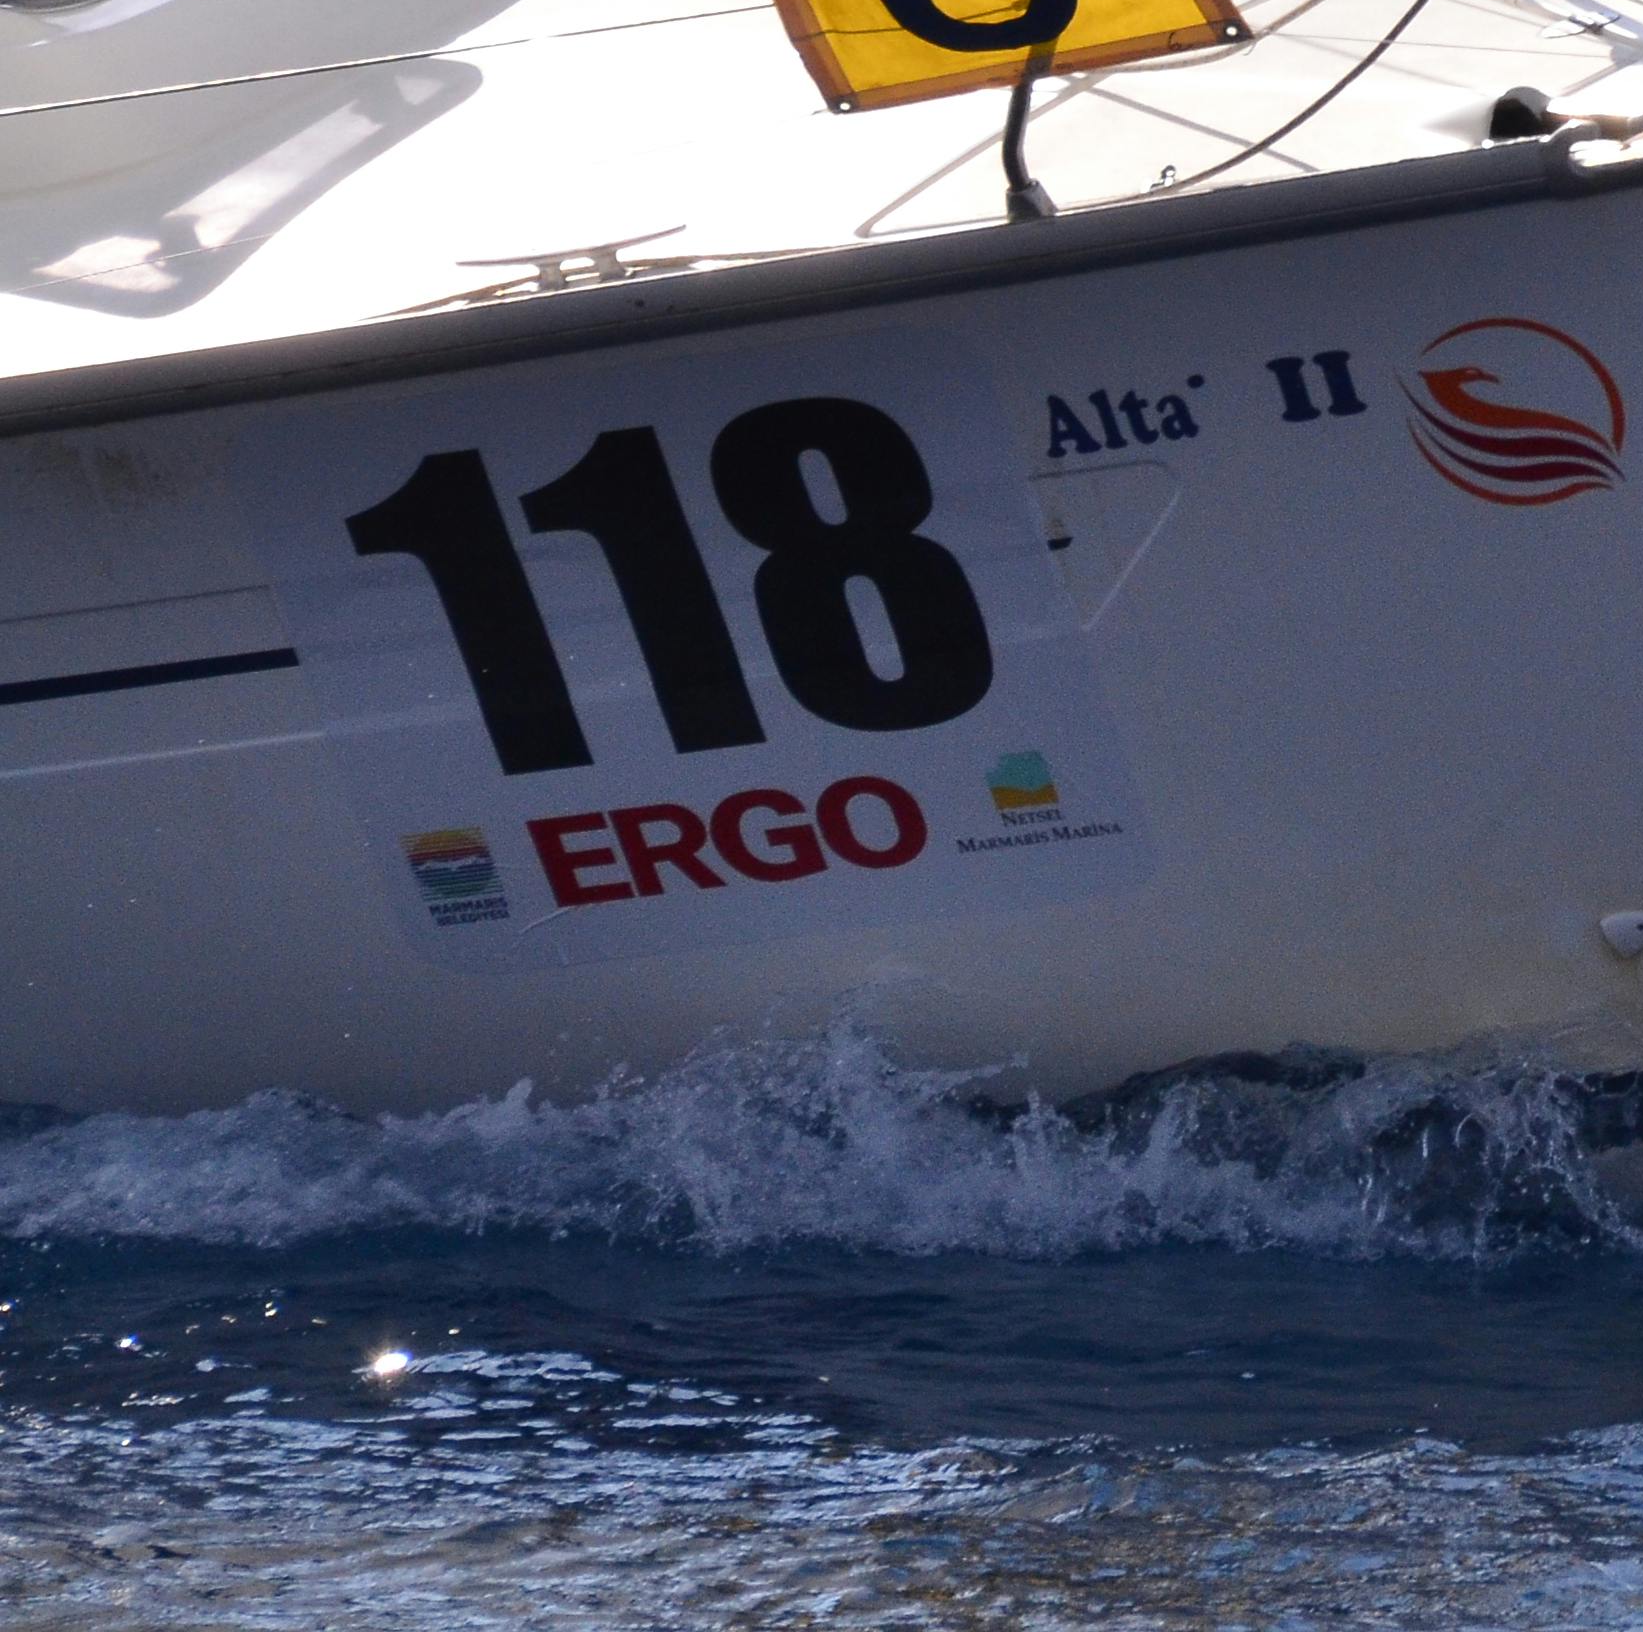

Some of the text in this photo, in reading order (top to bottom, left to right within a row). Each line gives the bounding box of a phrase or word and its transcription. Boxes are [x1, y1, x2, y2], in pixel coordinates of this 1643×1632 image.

[1266, 350, 1367, 423] II
[346, 397, 994, 776] 118
[525, 776, 928, 908] ERGO
